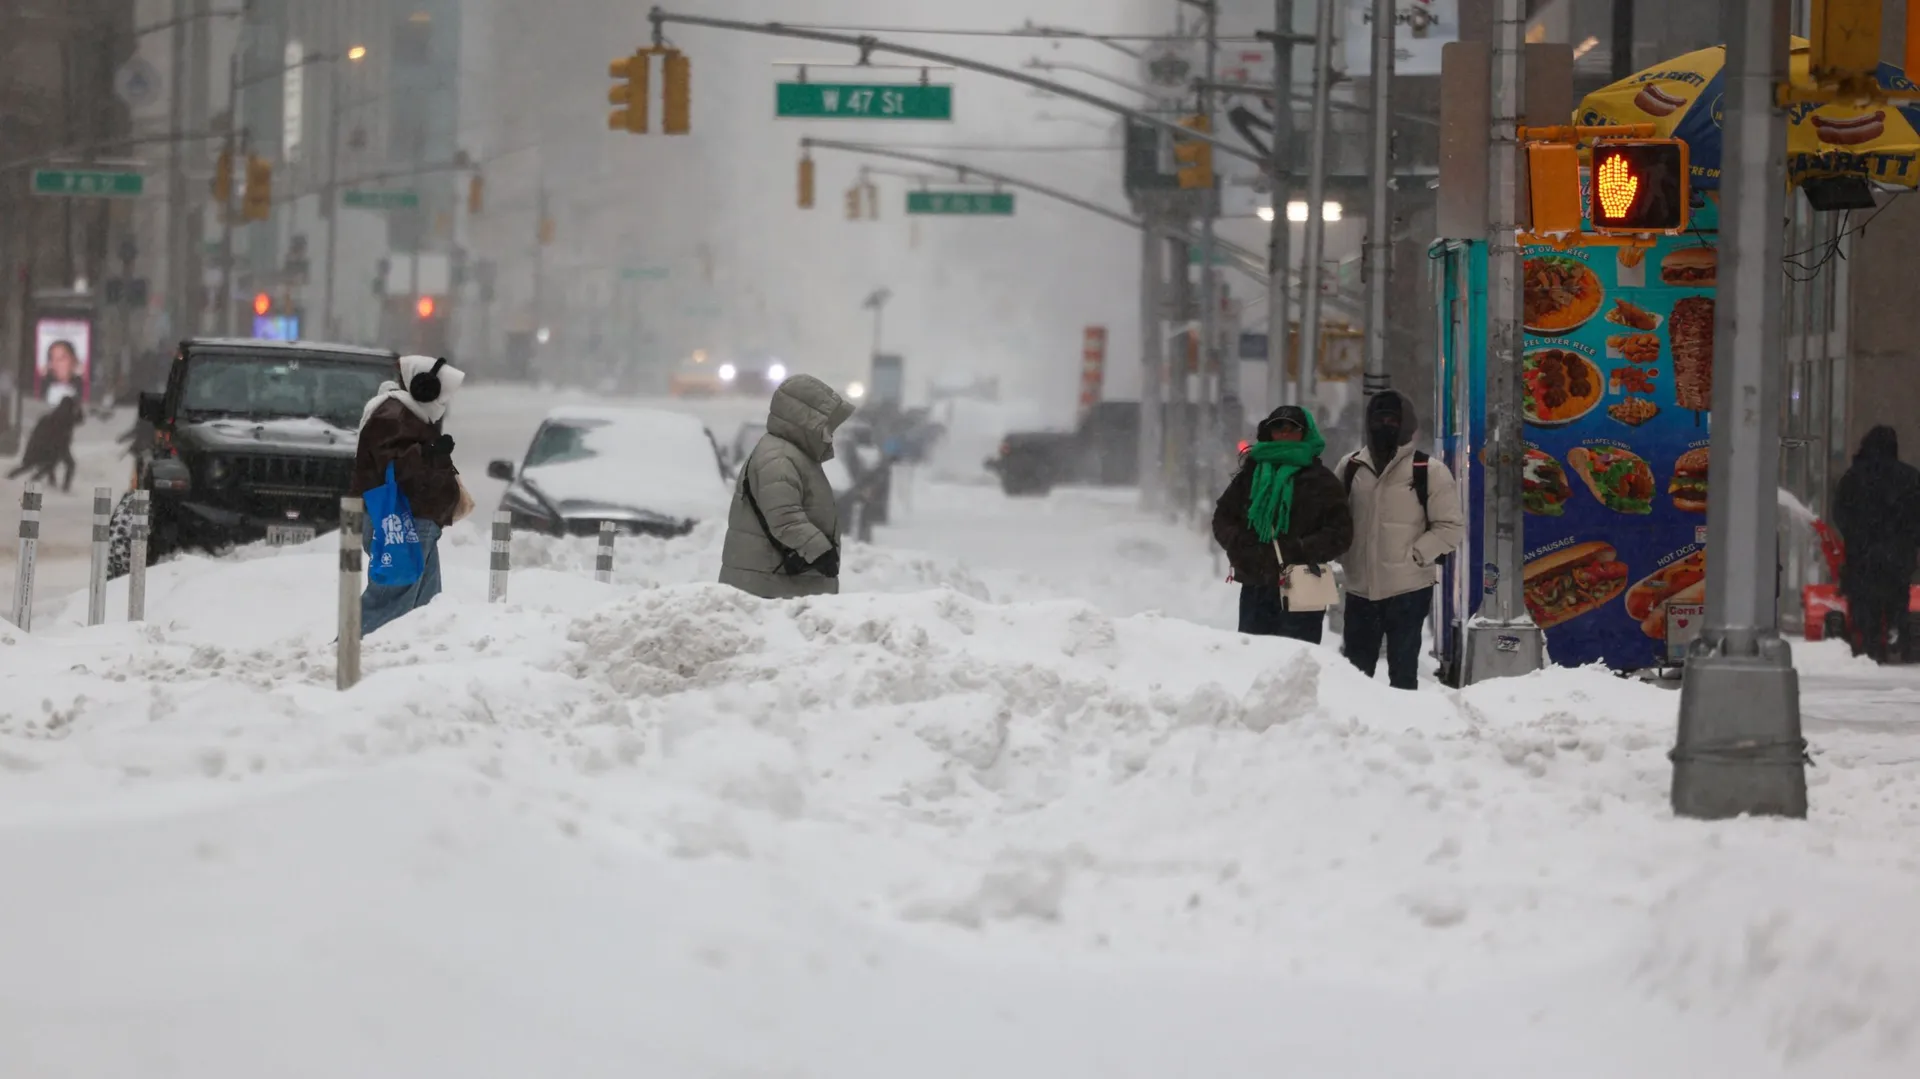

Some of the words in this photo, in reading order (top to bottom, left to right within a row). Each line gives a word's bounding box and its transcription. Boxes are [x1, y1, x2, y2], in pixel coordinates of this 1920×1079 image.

[821, 89, 840, 112] W
[846, 89, 874, 112] 47
[881, 91, 904, 114] St
[1567, 248, 1589, 260] RICE
[1523, 338, 1540, 348] FEL
[1544, 336, 1570, 347] OVER
[1573, 342, 1596, 355] RICE
[1523, 550, 1536, 563] AN
[1536, 535, 1576, 556] SAUSAGE
[1657, 551, 1676, 566] HOT
[1676, 542, 1697, 557] DOG
[1669, 605, 1695, 616] Corn
